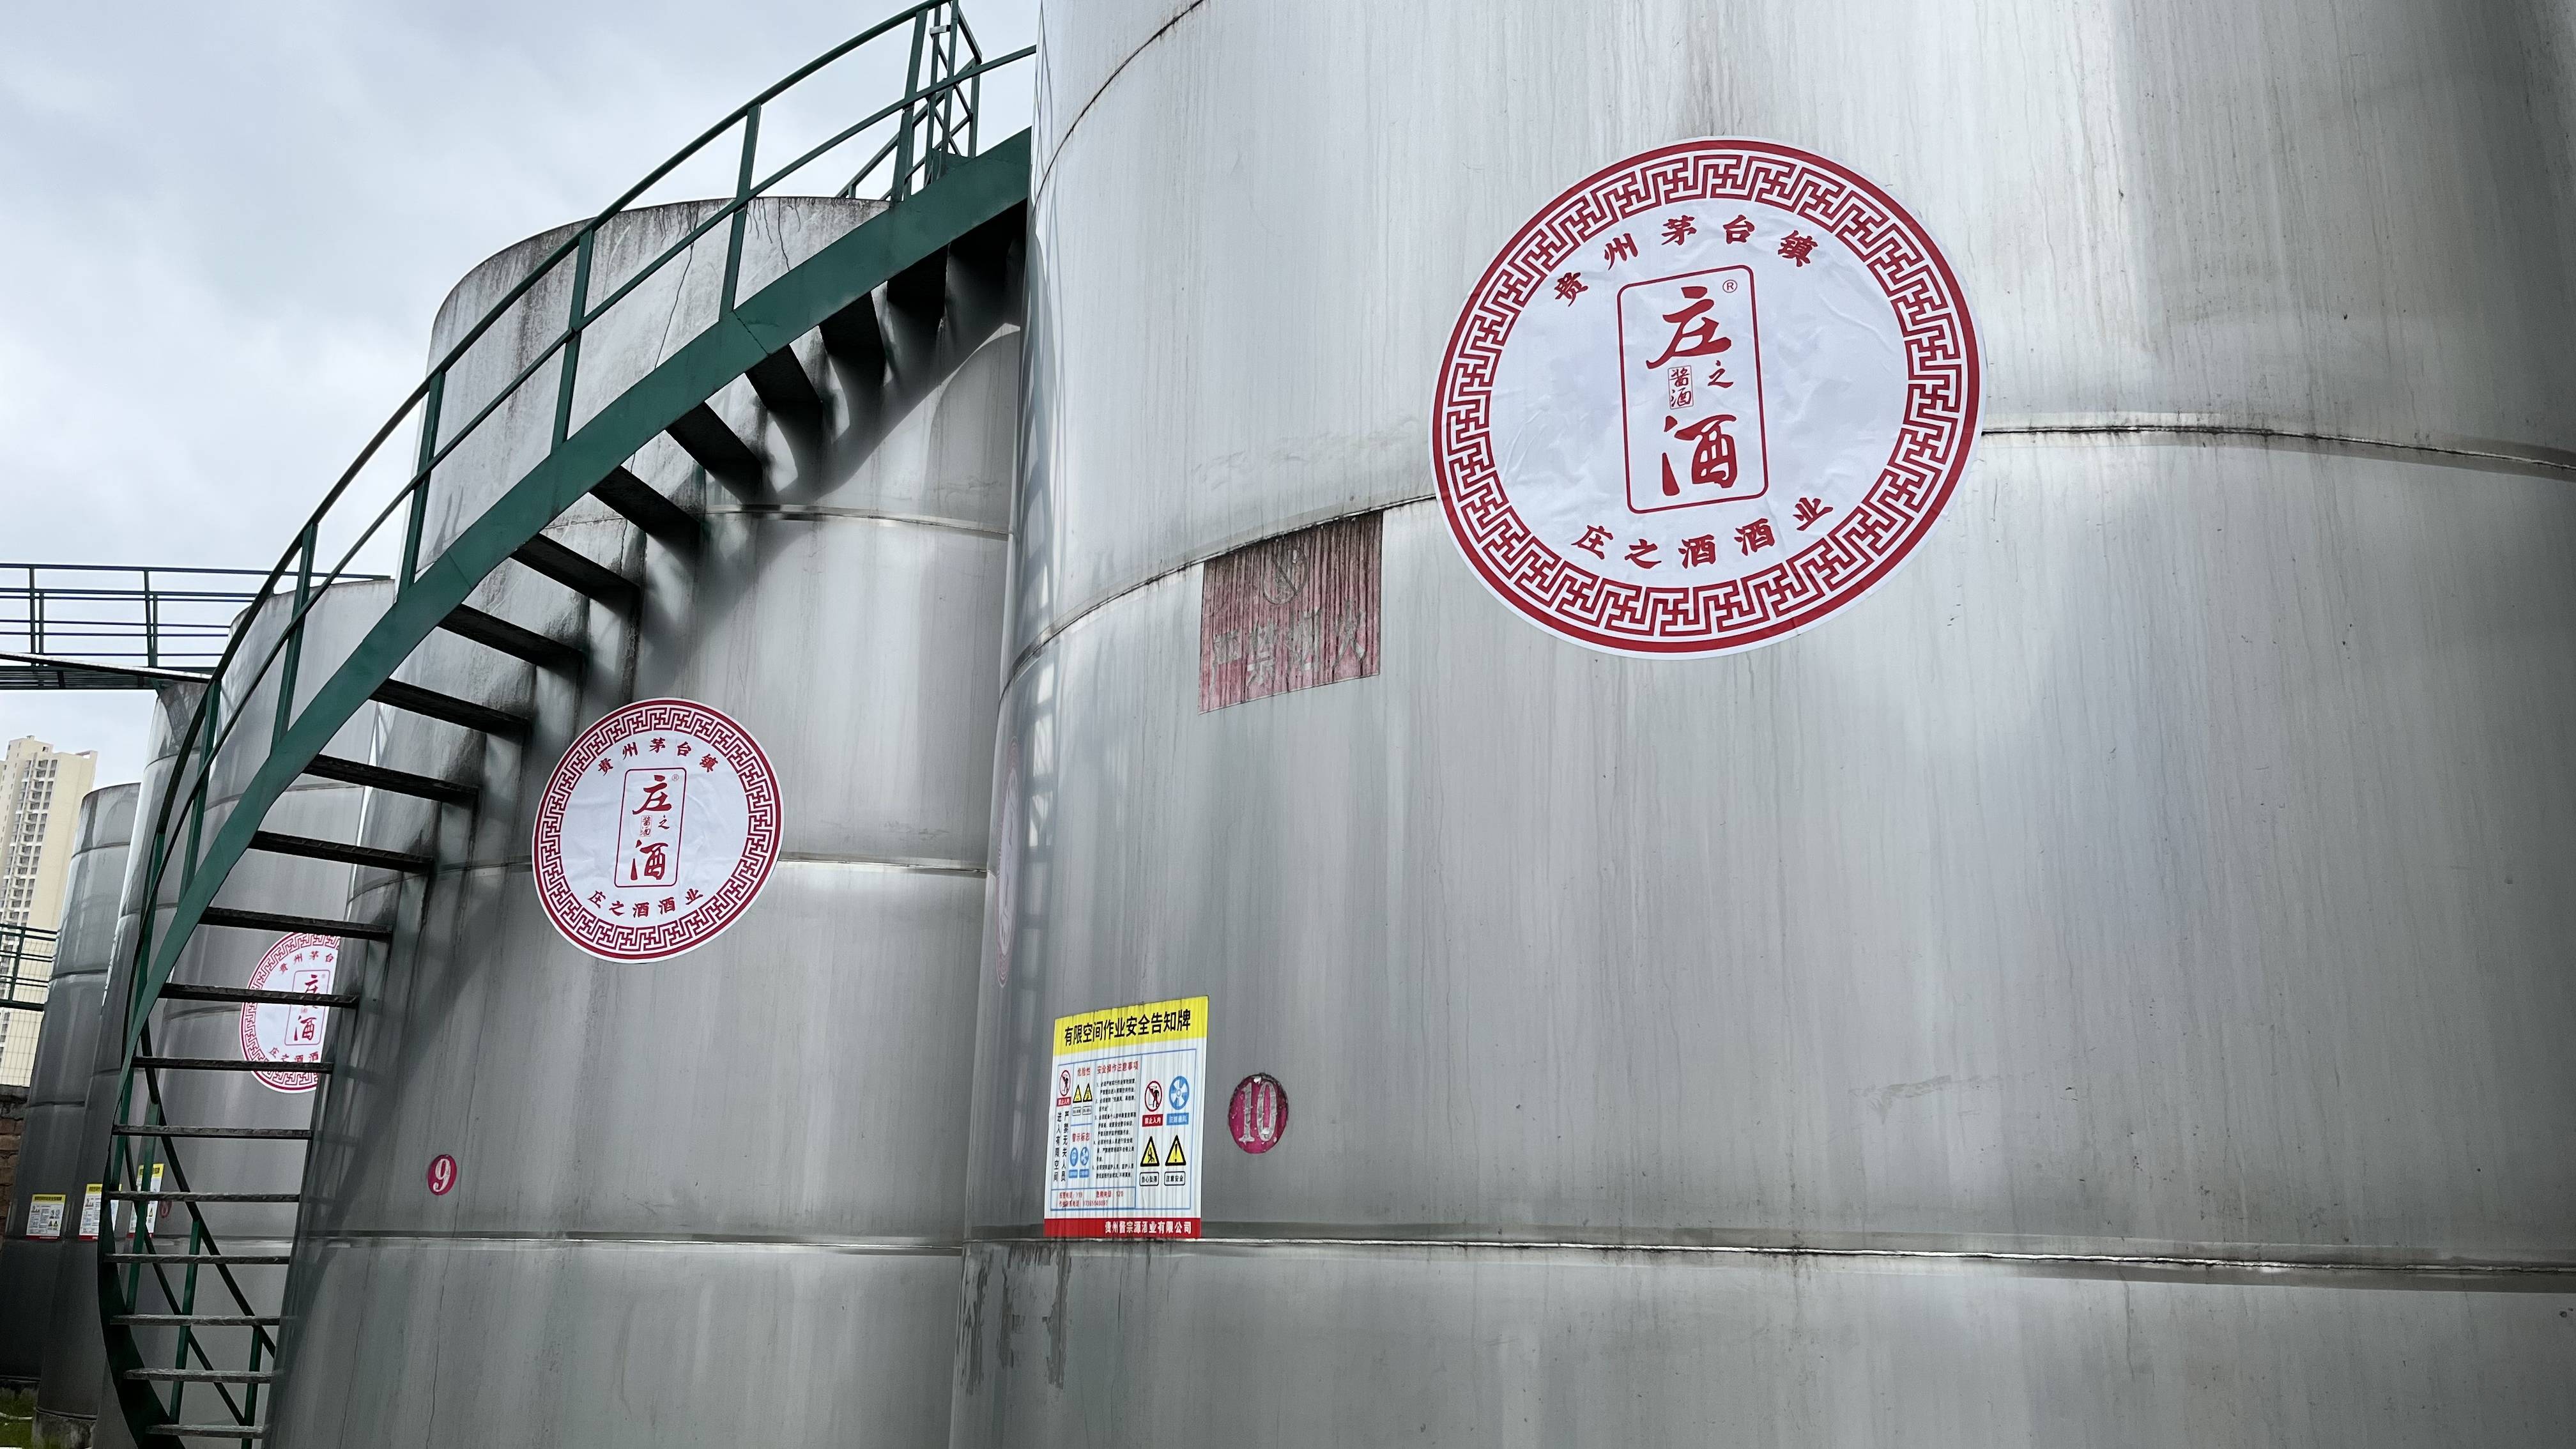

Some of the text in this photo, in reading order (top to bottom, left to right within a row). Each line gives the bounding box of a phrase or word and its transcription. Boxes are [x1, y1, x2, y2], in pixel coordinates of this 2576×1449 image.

[1554, 214, 1818, 307] 贵州茅台镇
[1570, 496, 1834, 570] 庄之酒酒业
[597, 737, 719, 776] 贵州茅台镇
[587, 887, 703, 918] 庄之酒酒业
[1064, 1008, 1191, 1046] 有限空间作业安全告知牌
[1239, 1081, 1278, 1143] 10
[1072, 1132, 1090, 1142] 警示标志
[433, 1158, 451, 1192] 9
